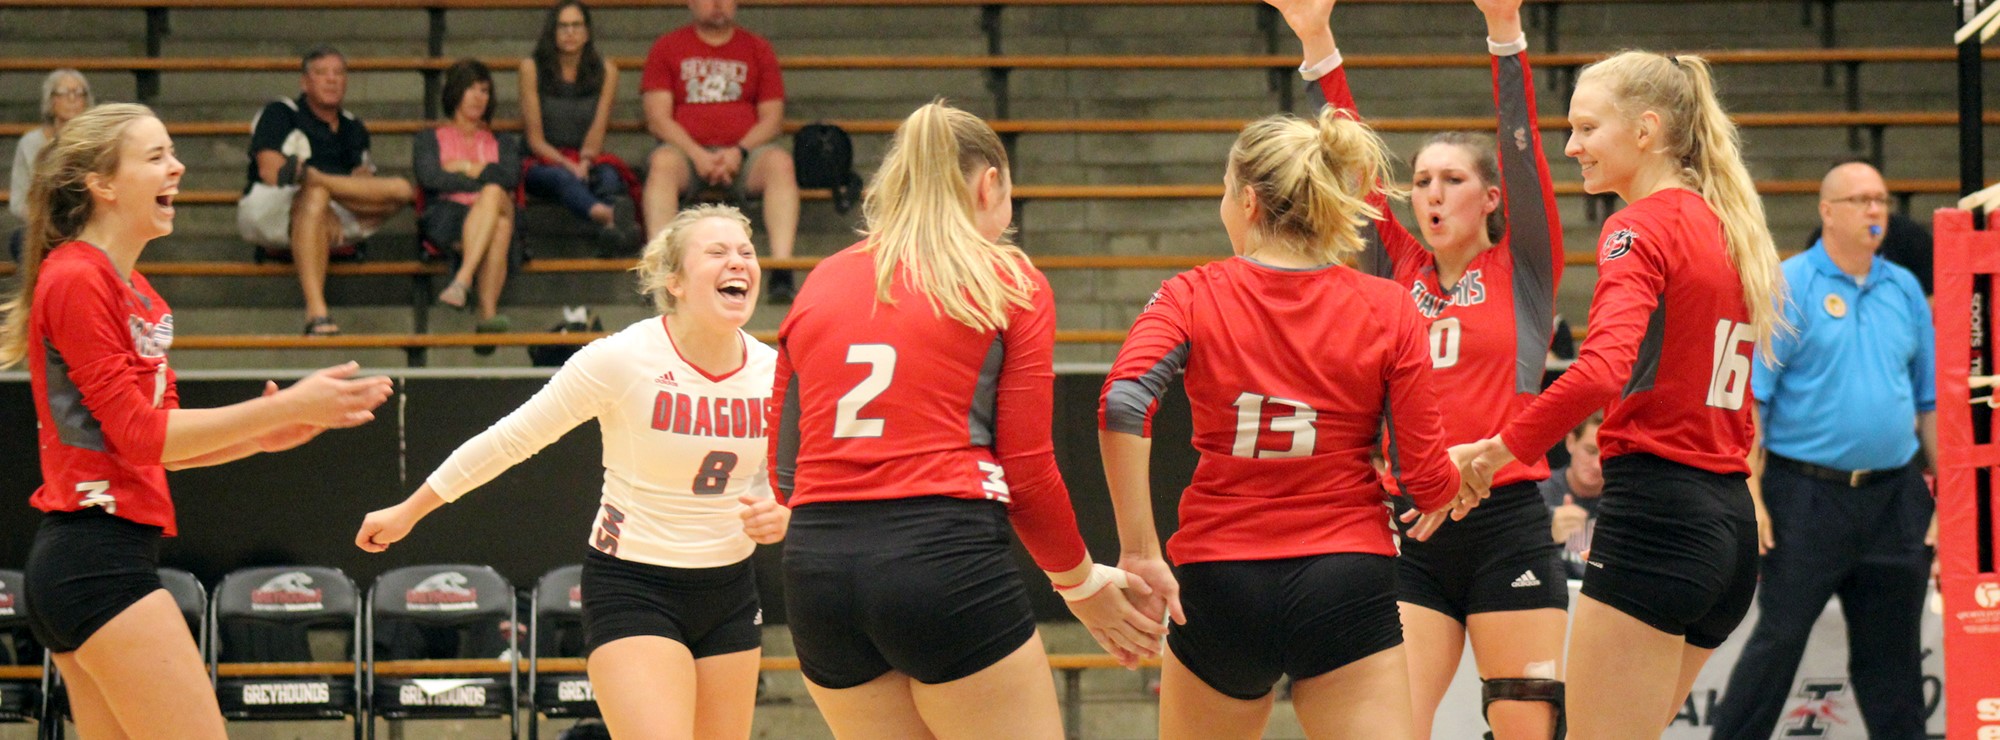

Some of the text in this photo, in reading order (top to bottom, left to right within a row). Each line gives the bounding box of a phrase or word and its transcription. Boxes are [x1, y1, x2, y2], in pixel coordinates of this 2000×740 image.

[833, 343, 897, 439] 2
[1705, 318, 1754, 411] 16
[1231, 391, 1318, 459] 13
[692, 450, 738, 495] 8
[243, 683, 330, 705] GREYHOUNDS
[558, 681, 594, 701] GREY
